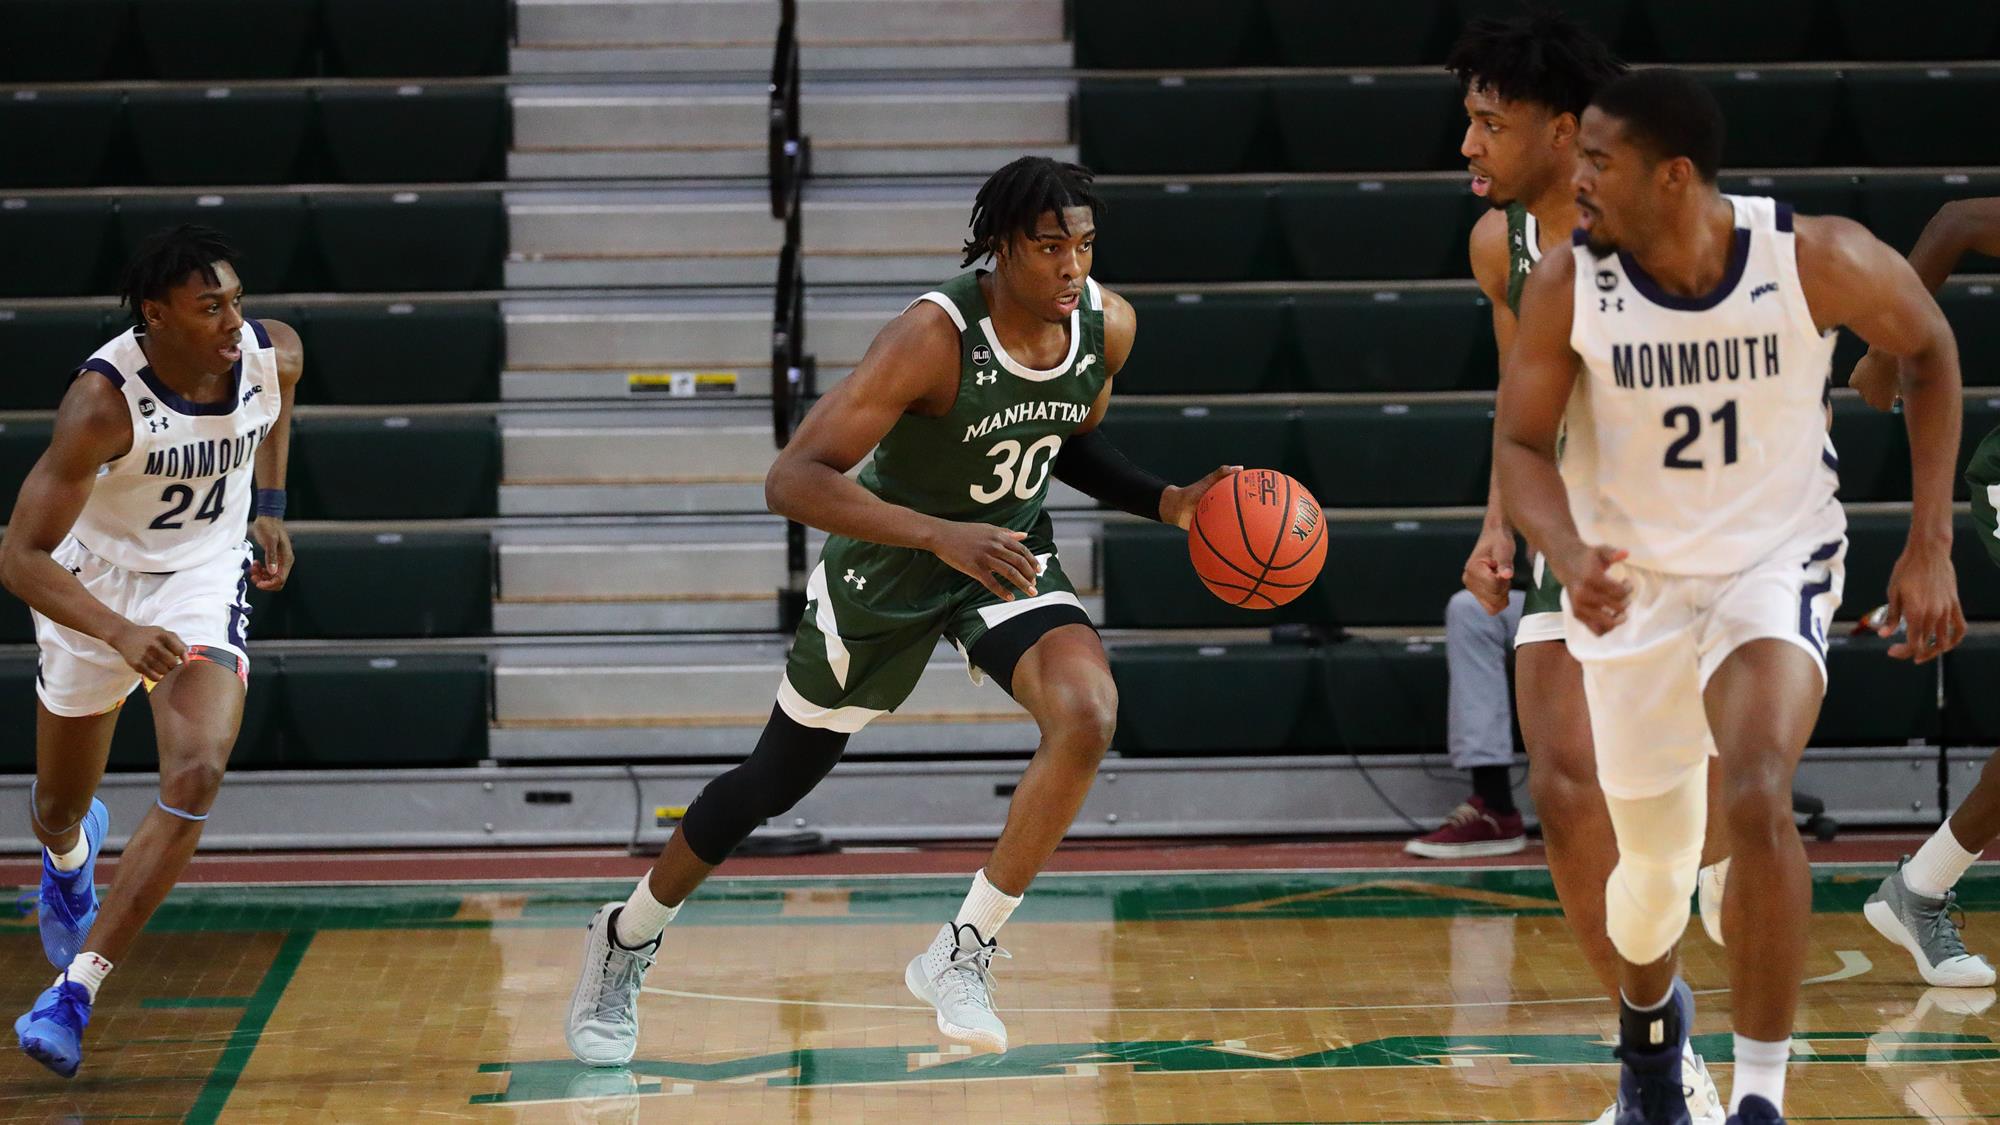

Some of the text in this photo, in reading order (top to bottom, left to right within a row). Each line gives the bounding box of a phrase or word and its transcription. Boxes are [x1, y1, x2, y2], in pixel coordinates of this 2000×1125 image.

[972, 350, 991, 361] BLM
[1612, 334, 1780, 389] MONMOUTH
[962, 401, 1091, 443] MANHATTAN
[1662, 400, 1738, 469] 21
[969, 434, 1062, 504] 30
[148, 475, 227, 530] 24
[1291, 495, 1320, 542] ROCK
